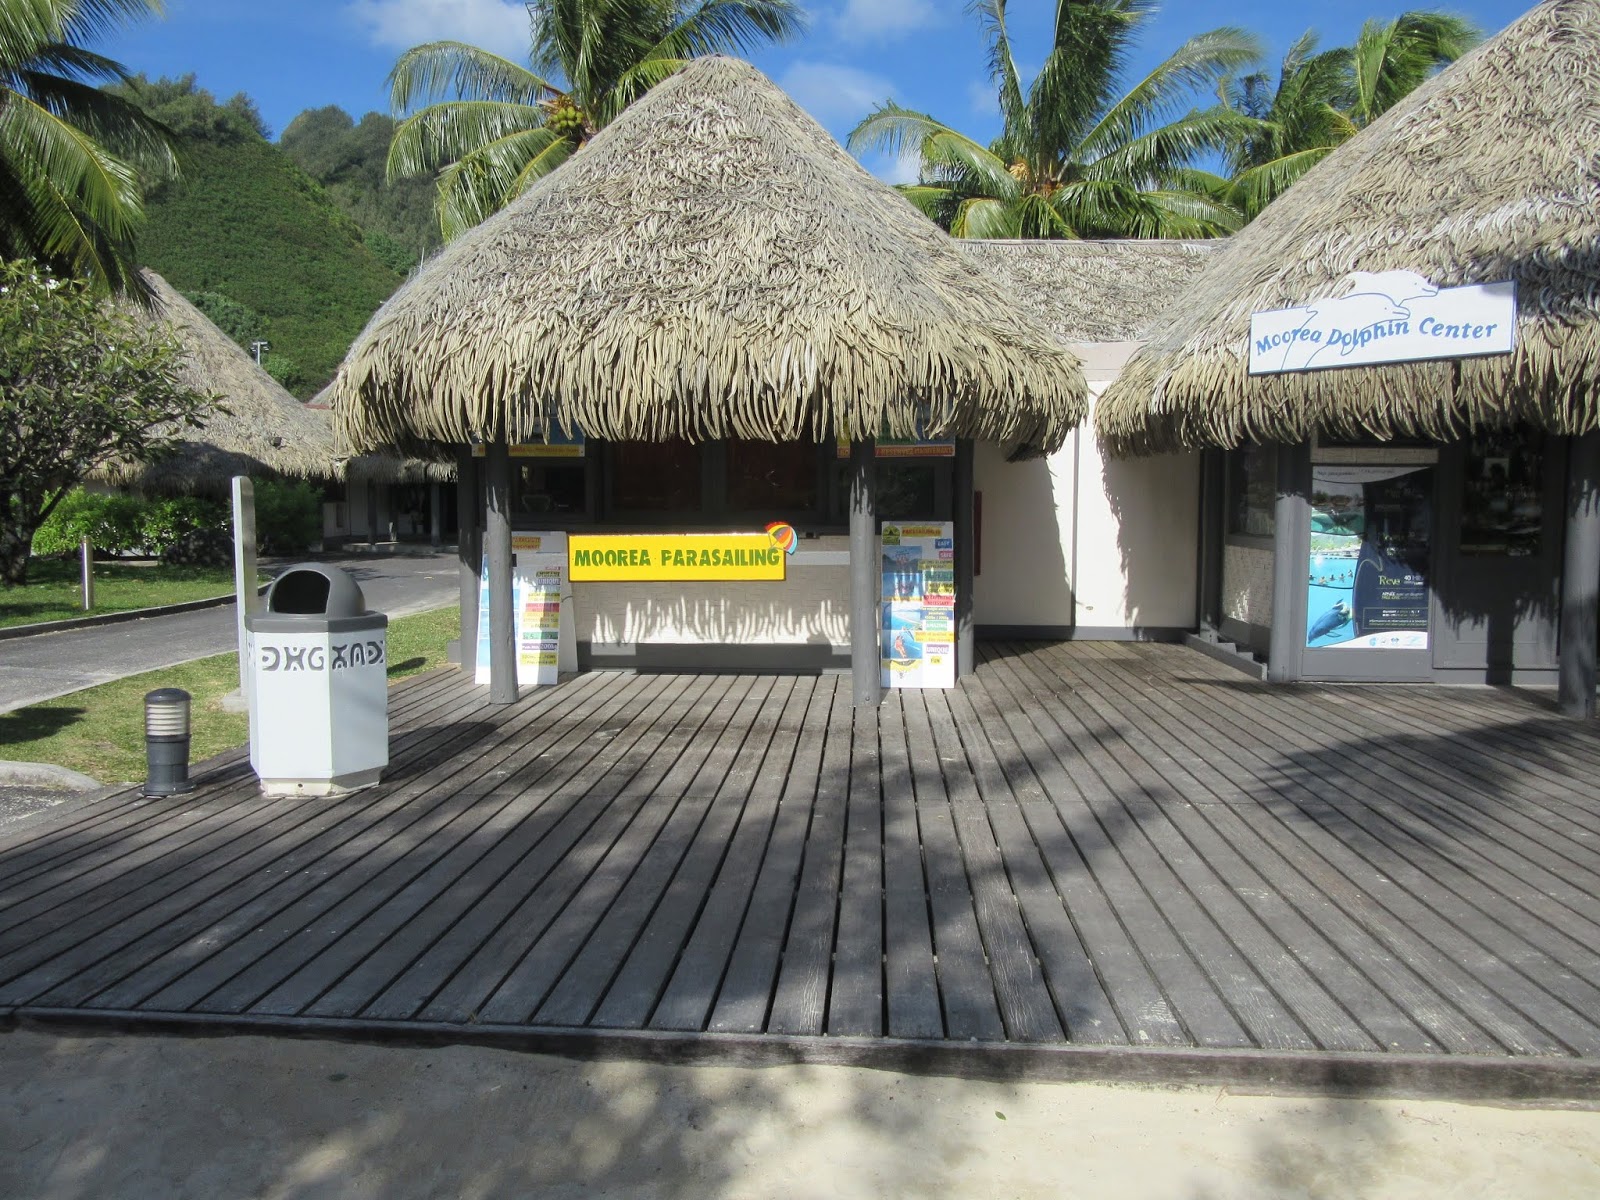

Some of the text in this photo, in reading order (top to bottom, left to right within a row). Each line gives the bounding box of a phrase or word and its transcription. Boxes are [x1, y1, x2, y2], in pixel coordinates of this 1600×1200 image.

[1256, 316, 1498, 356] Moorea Dolphin Center
[574, 549, 780, 567] MOOREA PARASAILING
